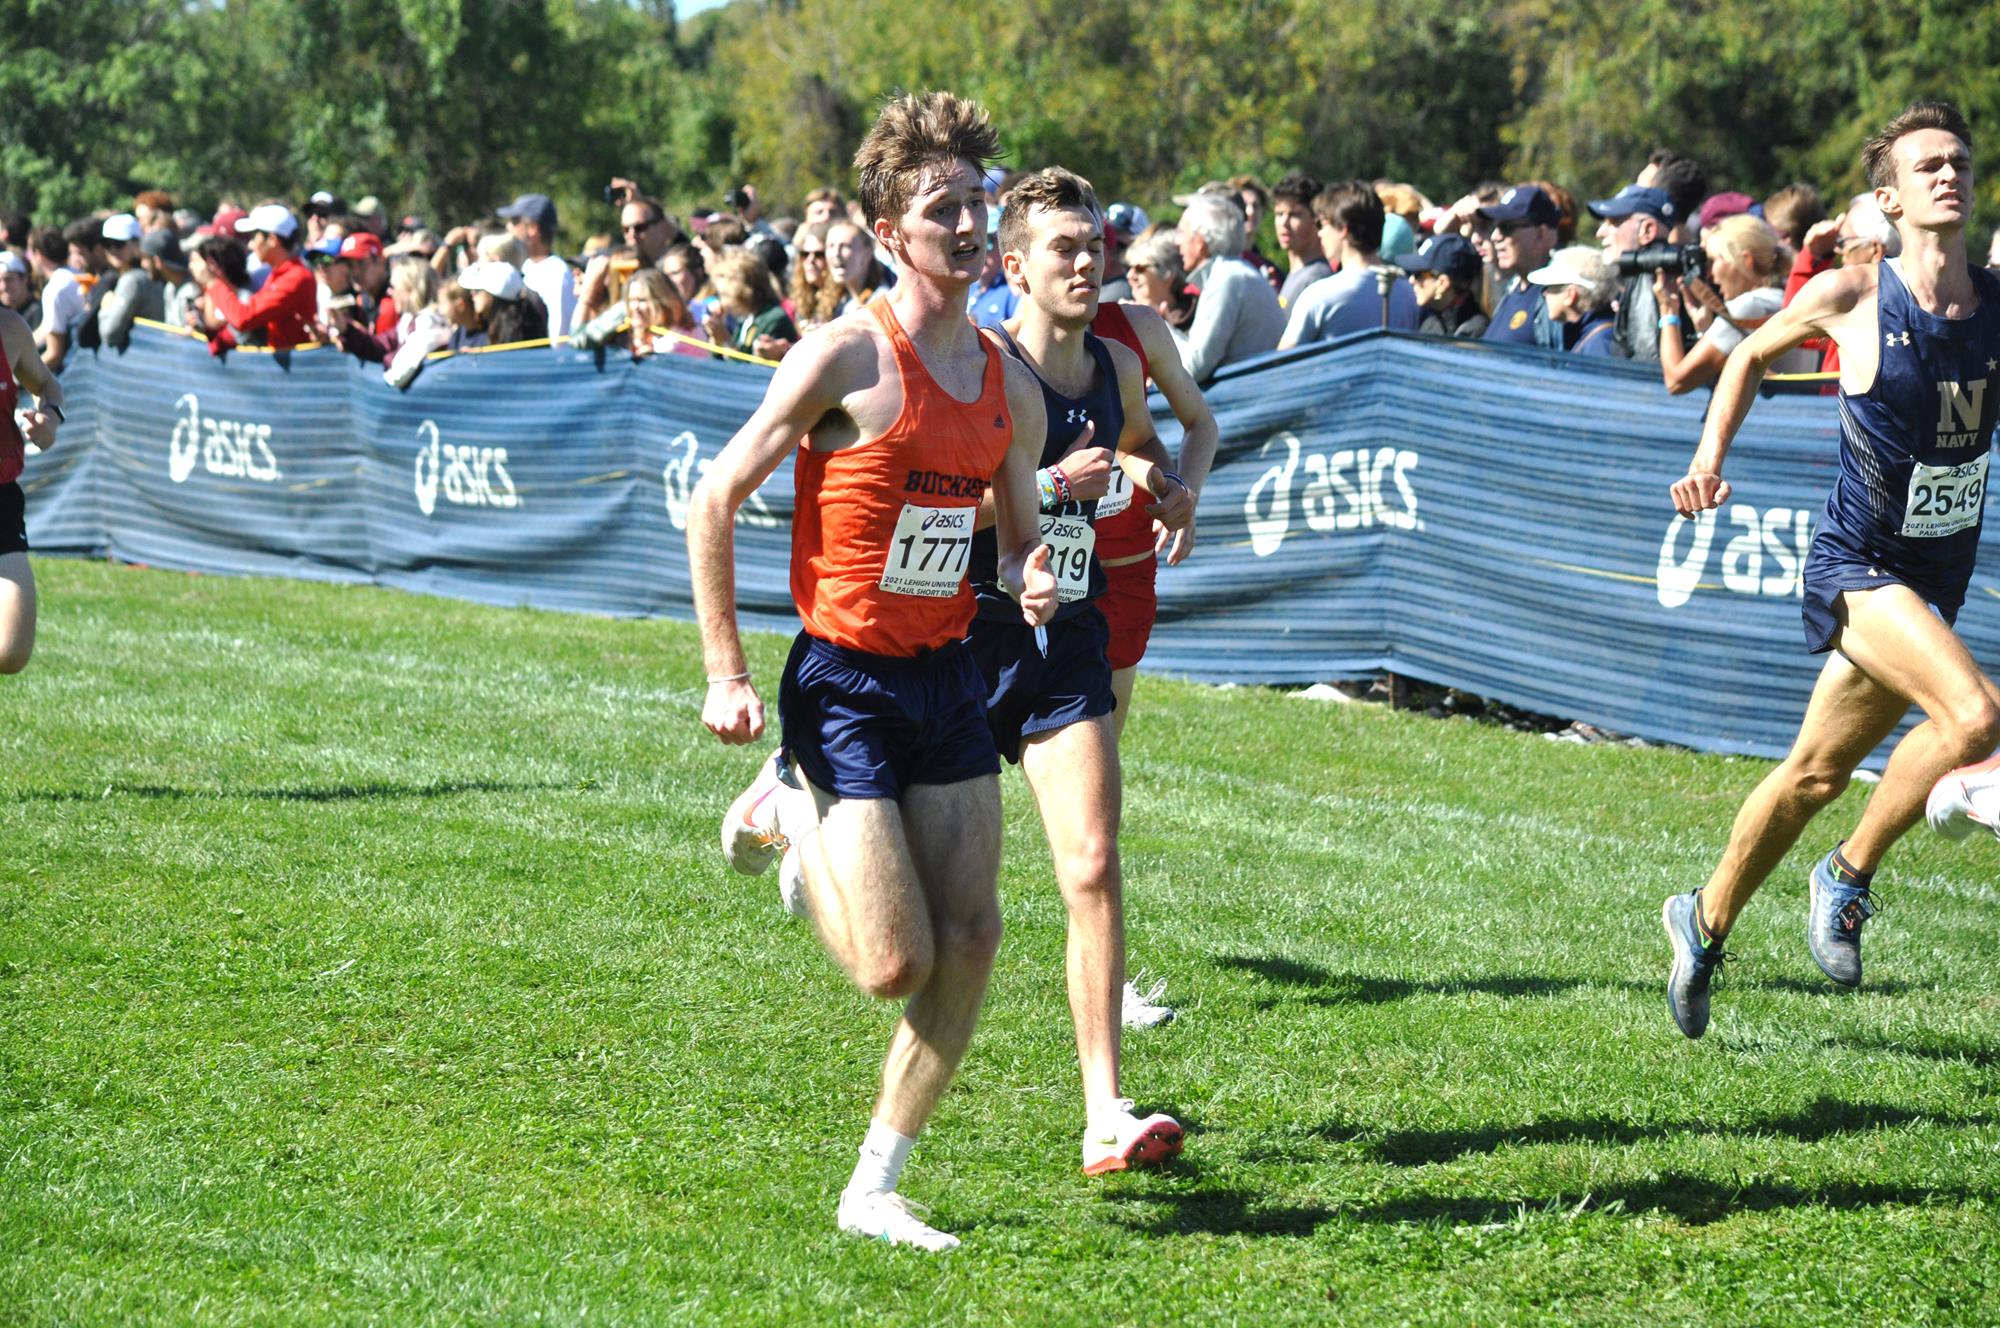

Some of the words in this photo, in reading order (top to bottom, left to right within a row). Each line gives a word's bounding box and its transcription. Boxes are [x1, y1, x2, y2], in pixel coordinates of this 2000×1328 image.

[1937, 379, 1987, 433] N
[203, 417, 278, 480] asics
[1936, 432, 1979, 448] NAVY
[443, 444, 518, 507] asics
[1302, 447, 1420, 531] asics
[1951, 463, 1980, 478] asics
[1912, 478, 1982, 516] 2549
[935, 513, 965, 529] asics
[1053, 523, 1084, 539] asics
[899, 534, 971, 573] 1777
[1722, 504, 1816, 598] asi
[885, 576, 902, 584] 2021
[904, 579, 930, 588] LEHIGH
[896, 587, 915, 595] PAUL
[916, 588, 939, 597] SHORT
